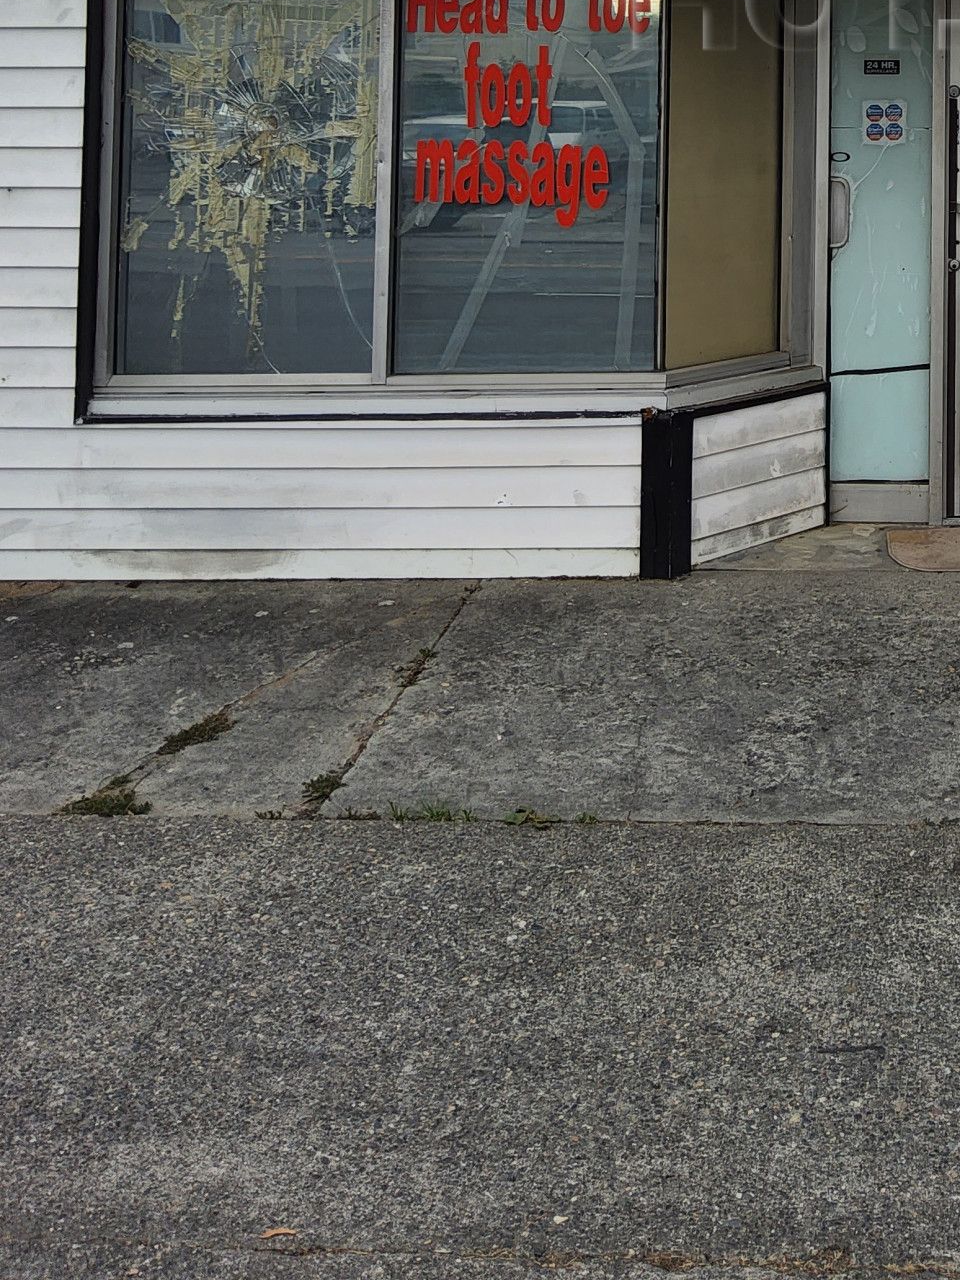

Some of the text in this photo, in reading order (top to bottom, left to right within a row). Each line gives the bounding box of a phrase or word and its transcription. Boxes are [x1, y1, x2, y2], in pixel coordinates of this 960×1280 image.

[464, 42, 553, 129] foot
[866, 61, 898, 69] 24 HR.
[414, 138, 610, 229] massage
